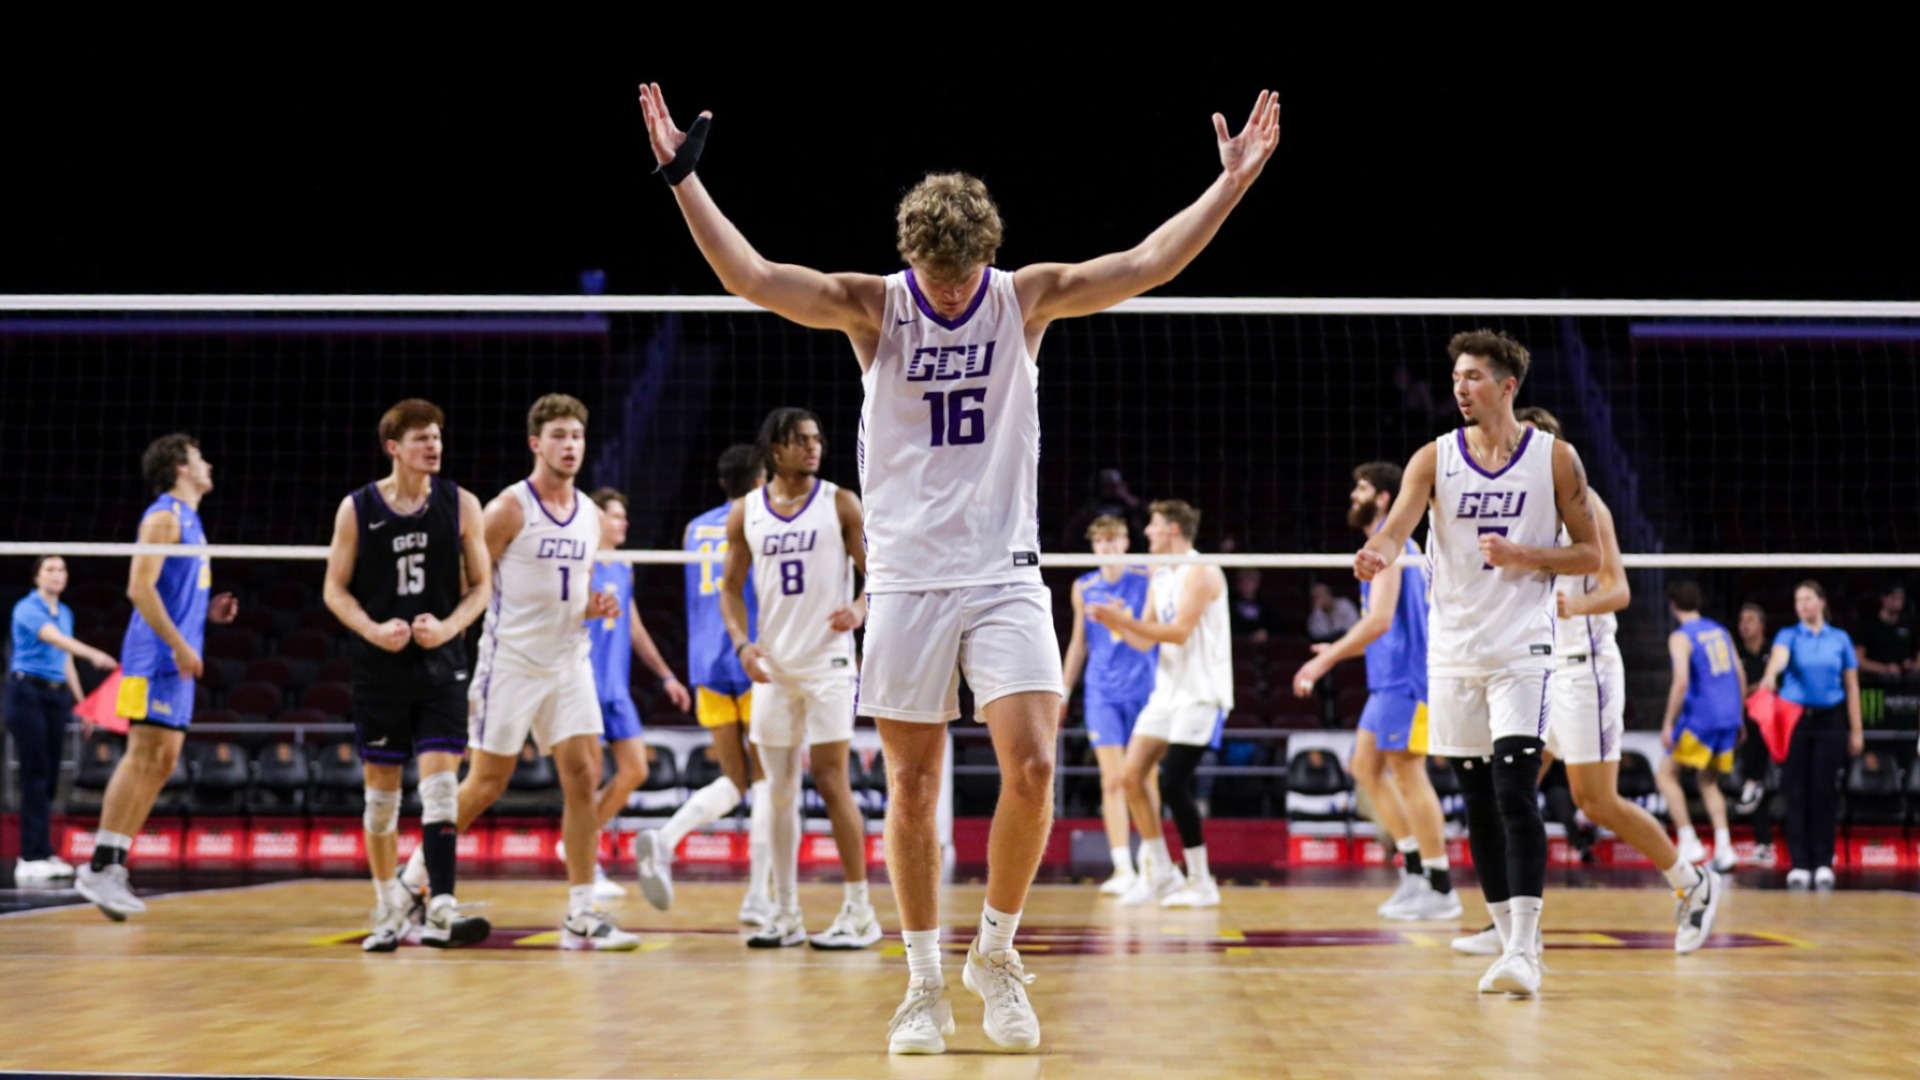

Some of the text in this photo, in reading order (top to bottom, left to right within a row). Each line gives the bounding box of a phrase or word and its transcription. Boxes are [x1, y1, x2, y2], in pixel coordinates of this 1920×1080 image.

[906, 340, 997, 382] GCU
[922, 387, 985, 447] 16
[1456, 491, 1527, 519] GCU
[393, 533, 428, 552] GCU
[537, 538, 586, 560] GCU
[762, 530, 817, 556] GCU
[397, 553, 426, 596] 15
[558, 566, 570, 602] 1
[780, 560, 804, 596] 8
